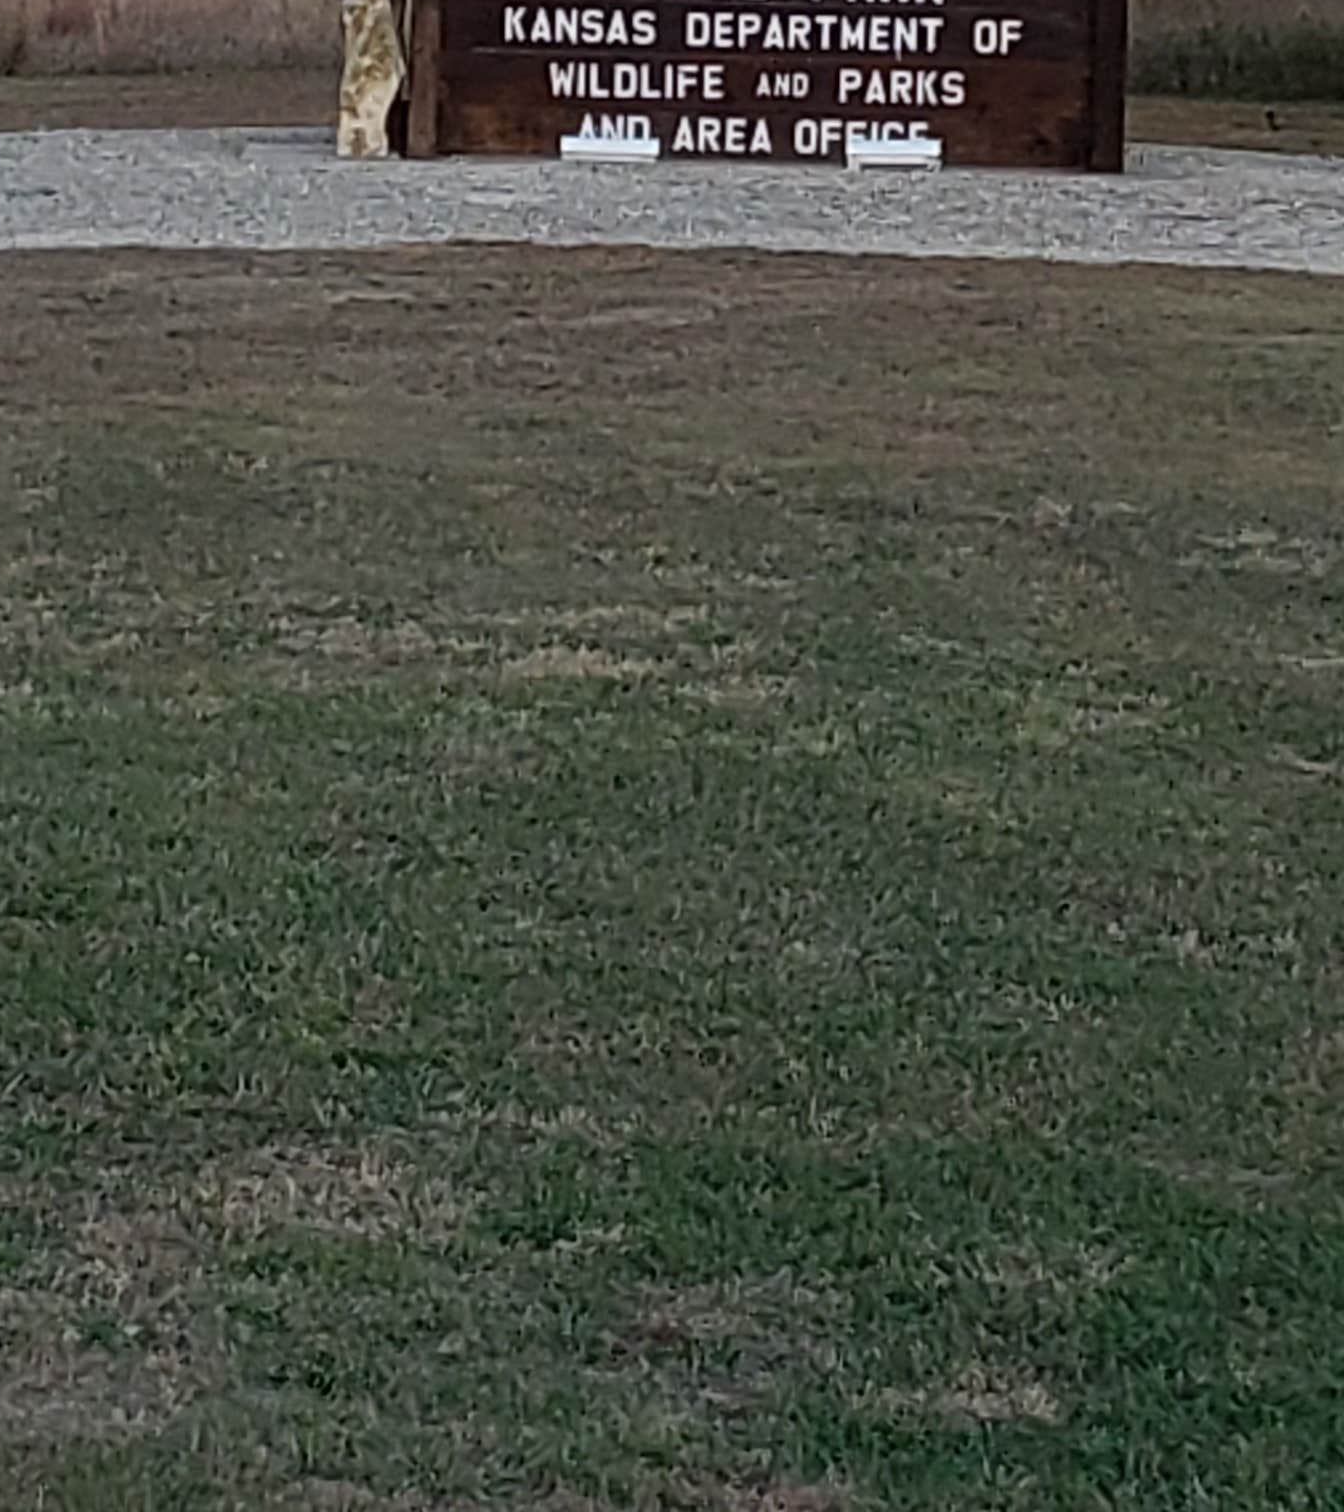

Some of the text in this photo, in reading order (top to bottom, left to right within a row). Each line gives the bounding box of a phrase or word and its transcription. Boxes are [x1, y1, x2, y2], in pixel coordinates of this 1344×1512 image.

[504, 7, 1022, 55] KANSAS DEPARTMENT OF
[549, 63, 965, 105] WILDLIFE AND PARKS
[579, 113, 651, 139] AND
[672, 117, 772, 152] AREA
